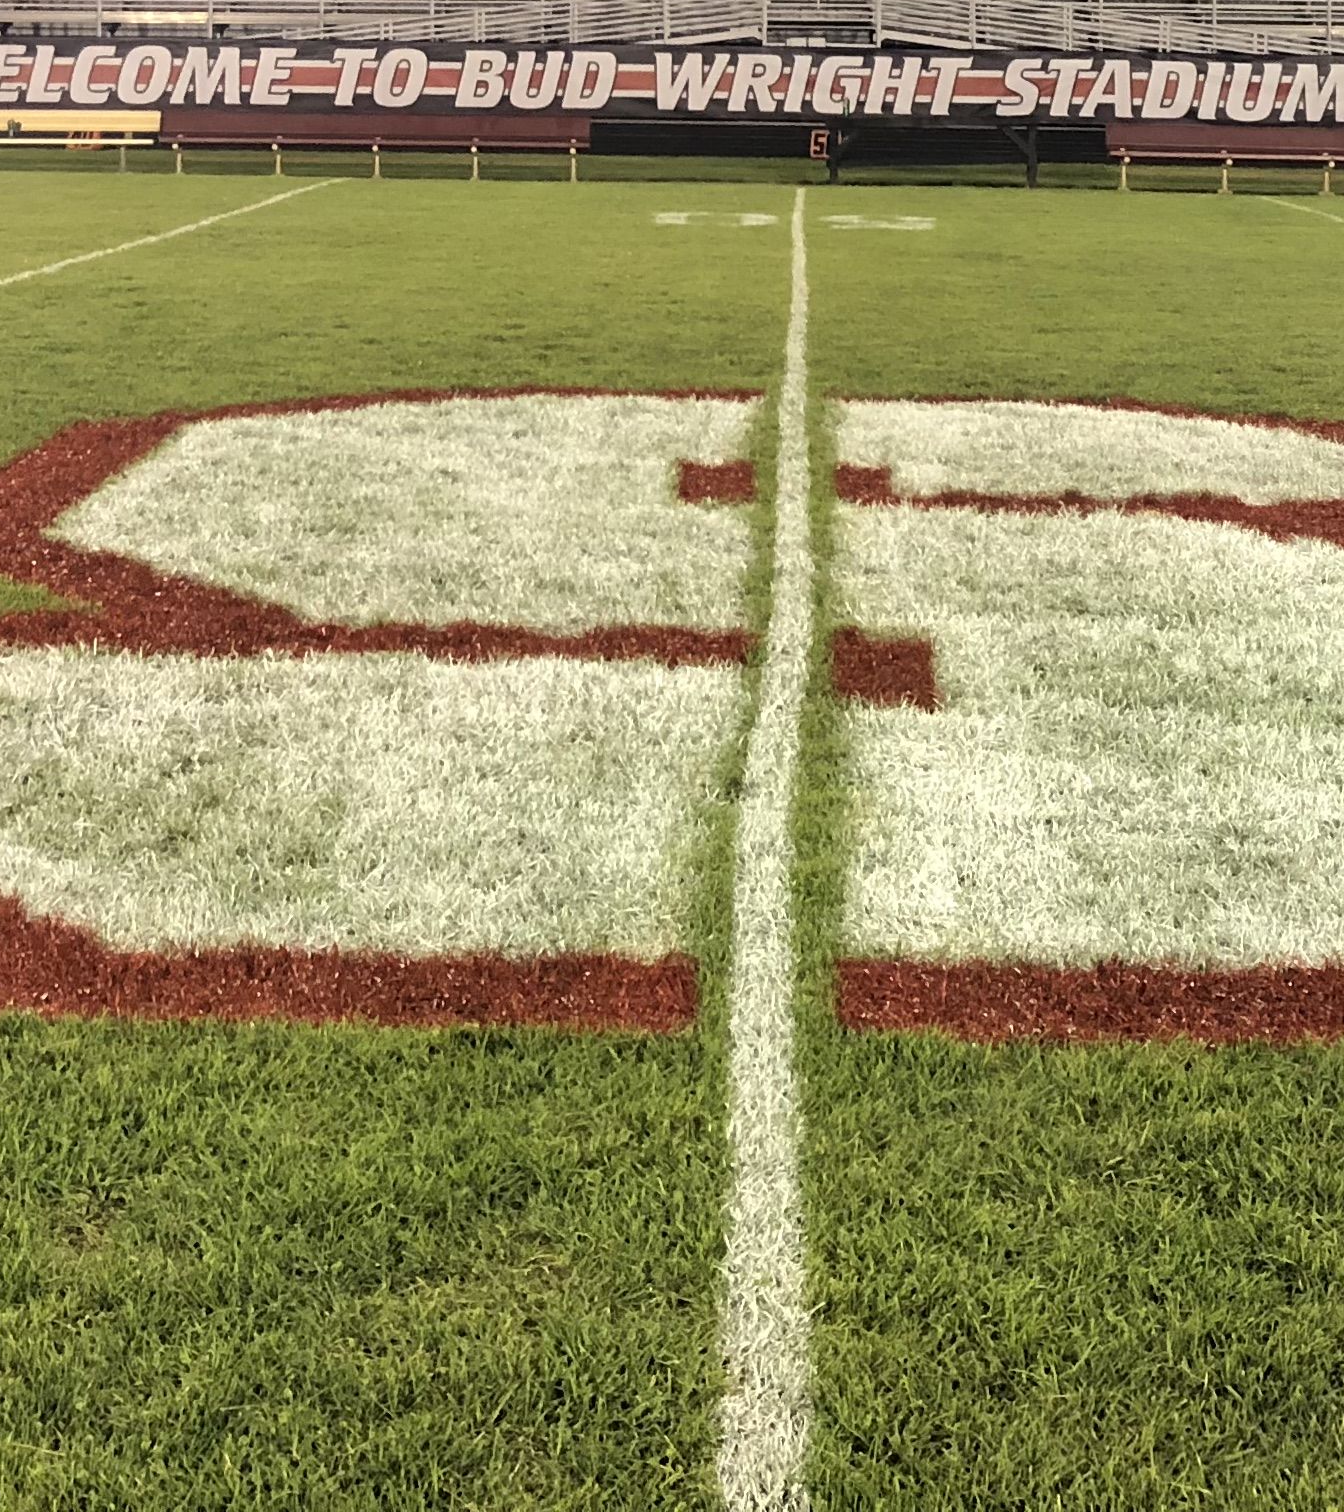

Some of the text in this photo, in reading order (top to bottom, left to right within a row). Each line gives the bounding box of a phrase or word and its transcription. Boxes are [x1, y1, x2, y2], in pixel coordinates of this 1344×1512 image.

[331, 47, 430, 108] TO
[455, 49, 617, 111] BUD
[654, 52, 974, 116] WRIGHT
